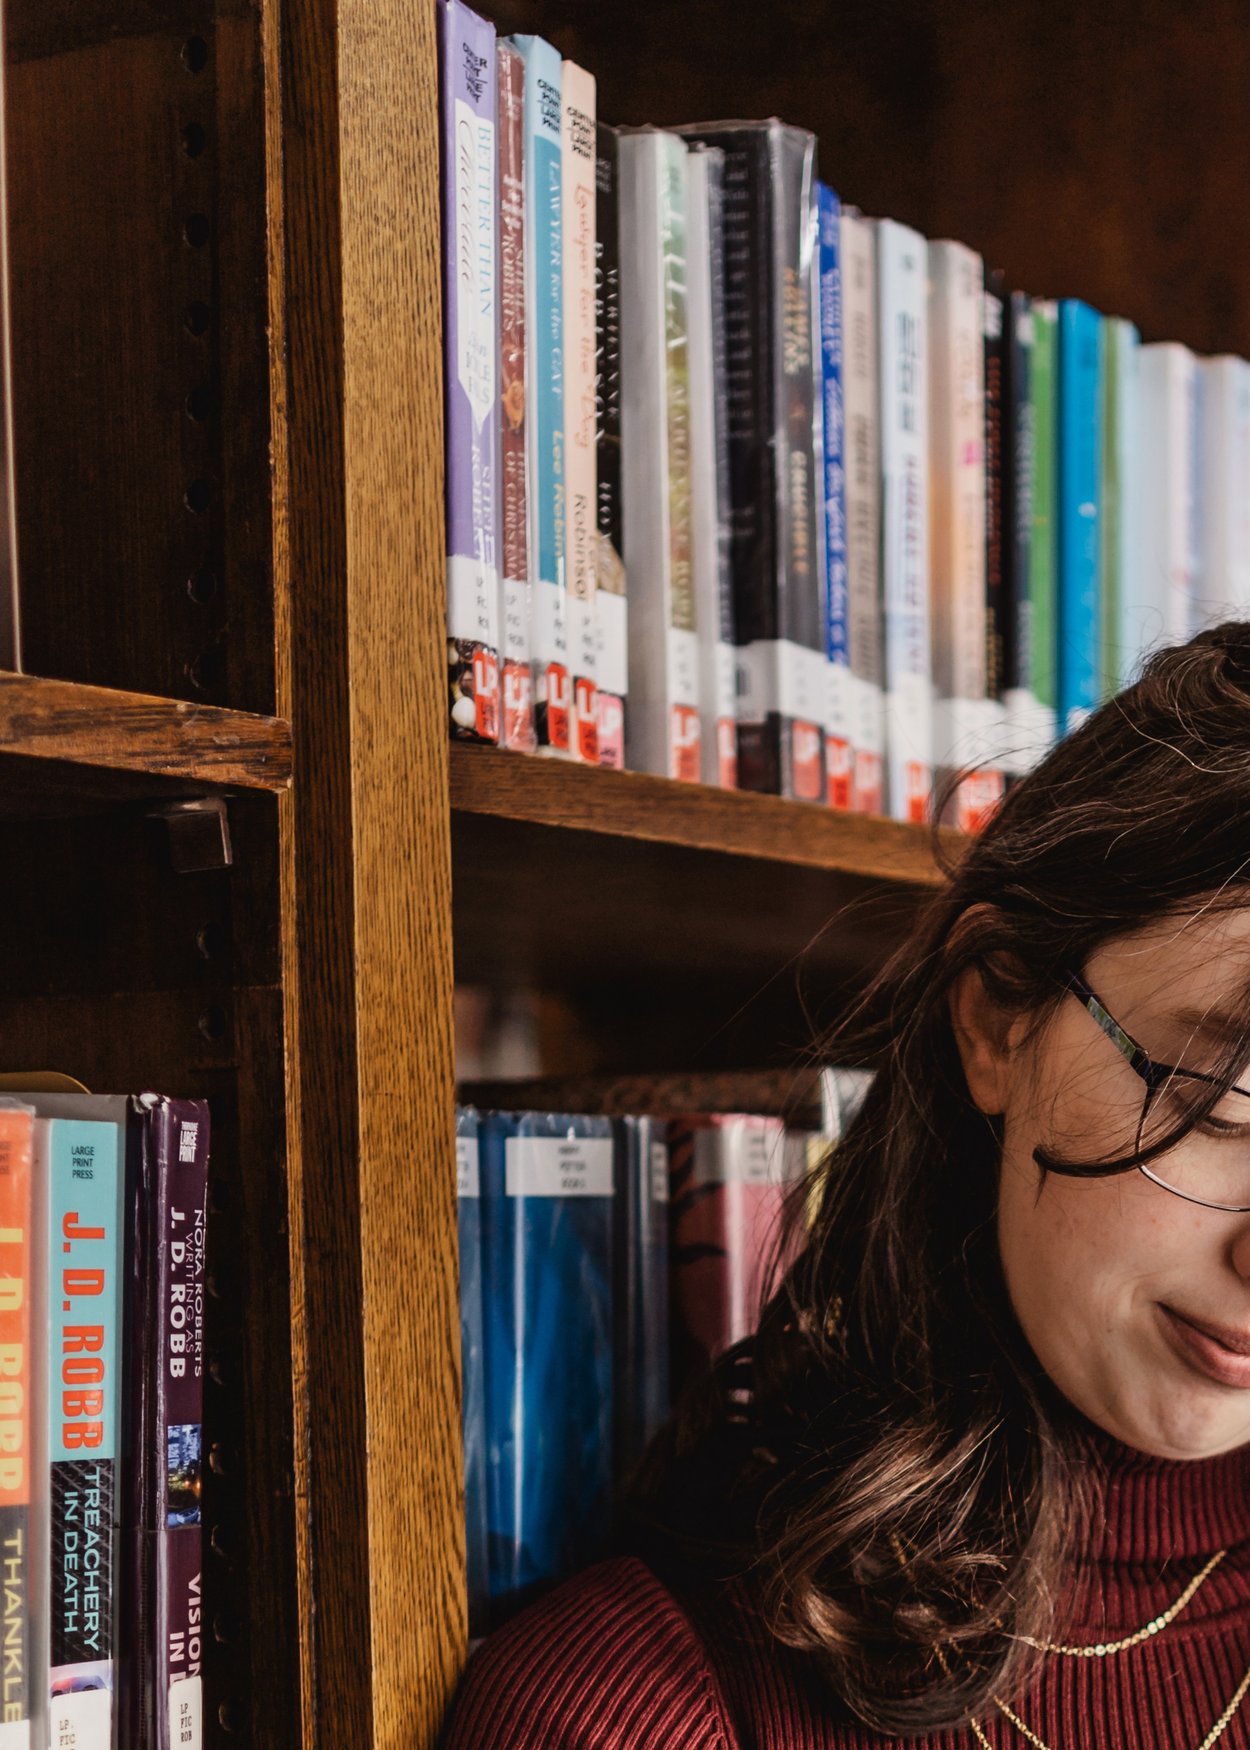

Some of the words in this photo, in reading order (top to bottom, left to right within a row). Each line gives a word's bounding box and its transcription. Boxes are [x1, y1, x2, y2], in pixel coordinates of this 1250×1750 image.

[71, 1146, 95, 1156] LARGE
[72, 1158, 94, 1168] PRINT
[72, 1169, 94, 1180] PRESS
[62, 1211, 106, 1253] J.
[170, 1206, 186, 1229] J.
[170, 1241, 186, 1272] D.
[194, 1209, 203, 1276] NORA
[62, 1268, 106, 1312] D.
[185, 1233, 195, 1321] WRITING
[169, 1283, 187, 1378] ROBB
[185, 1329, 195, 1354] AS
[194, 1283, 203, 1378] ROBERTS
[61, 1325, 105, 1450] ROBB
[64, 1491, 79, 1521] IN
[83, 1466, 101, 1651] TREACHERY
[63, 1531, 79, 1633] DEATH
[169, 1631, 185, 1663] IN
[180, 1702, 189, 1714] LP
[180, 1716, 192, 1729] FIC
[59, 1734, 76, 1746] FIC
[180, 1730, 193, 1743] ROB
